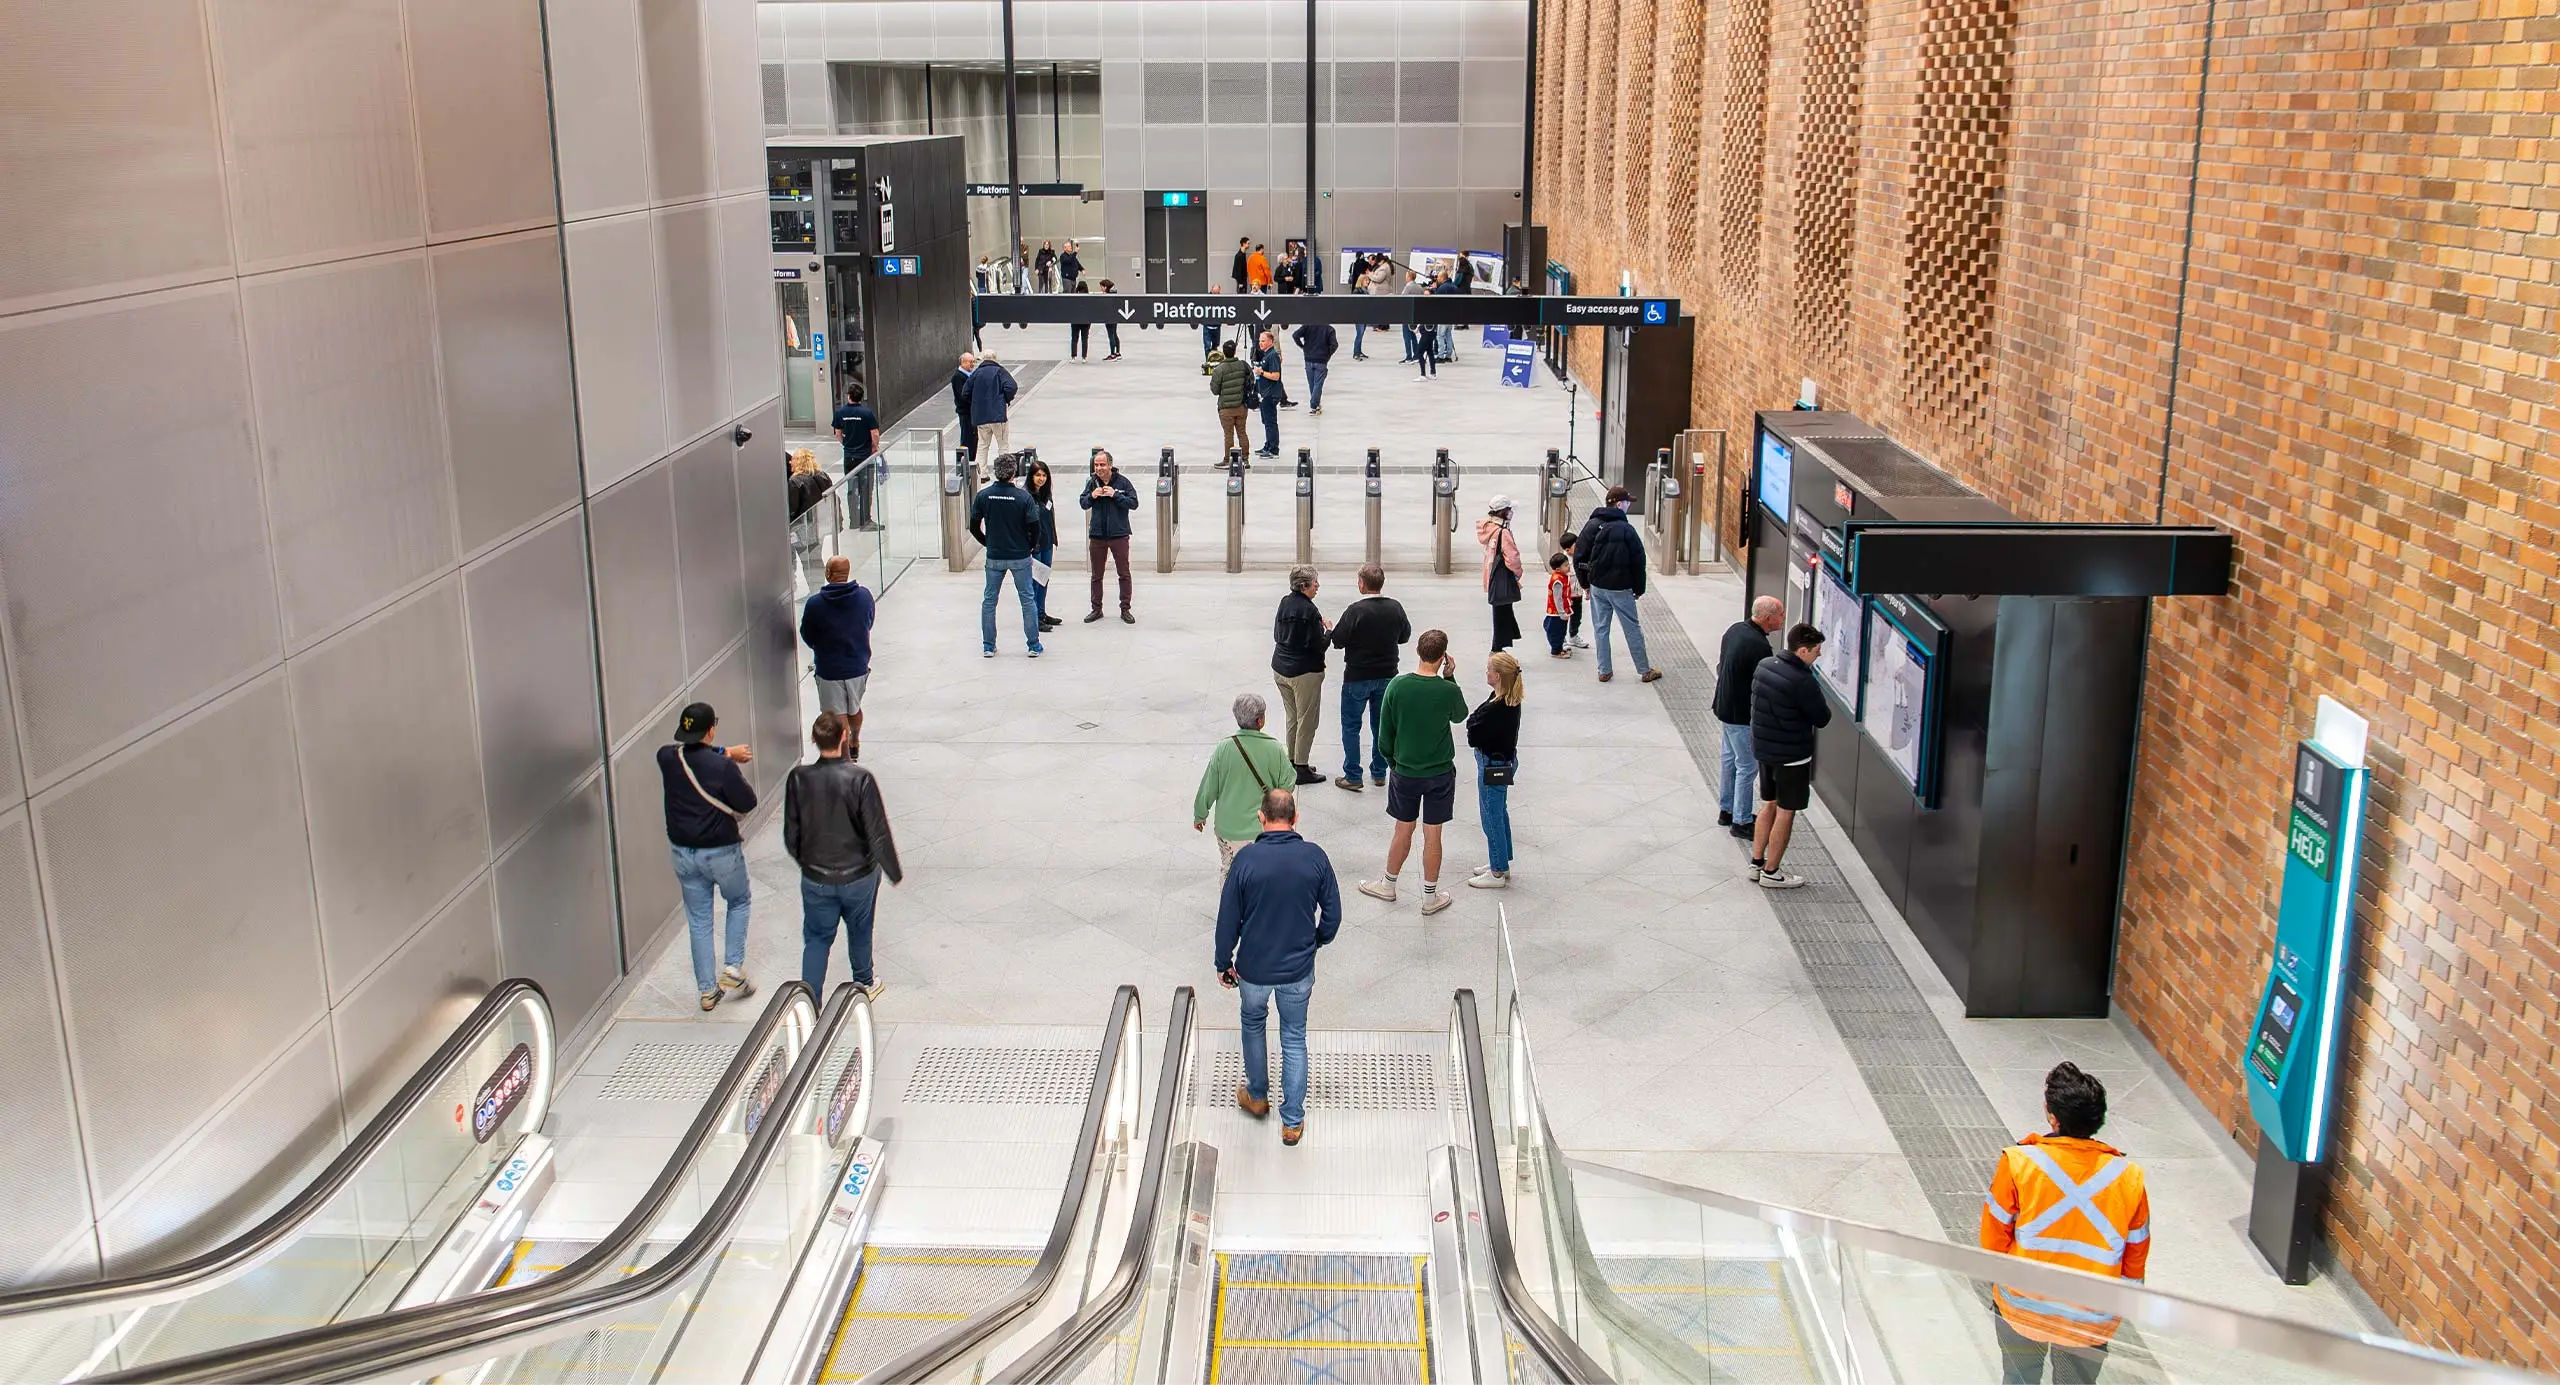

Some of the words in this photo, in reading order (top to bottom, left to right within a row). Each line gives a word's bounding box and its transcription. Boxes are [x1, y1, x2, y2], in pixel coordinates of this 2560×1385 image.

[976, 185, 1009, 194] Platform
[1153, 302, 1237, 318] Platforms
[1566, 304, 1587, 315] Easy
[1587, 305, 1618, 314] access
[1618, 305, 1639, 315] gate
[2294, 815, 2327, 849] Emergency
[2291, 828, 2325, 868] HELP
